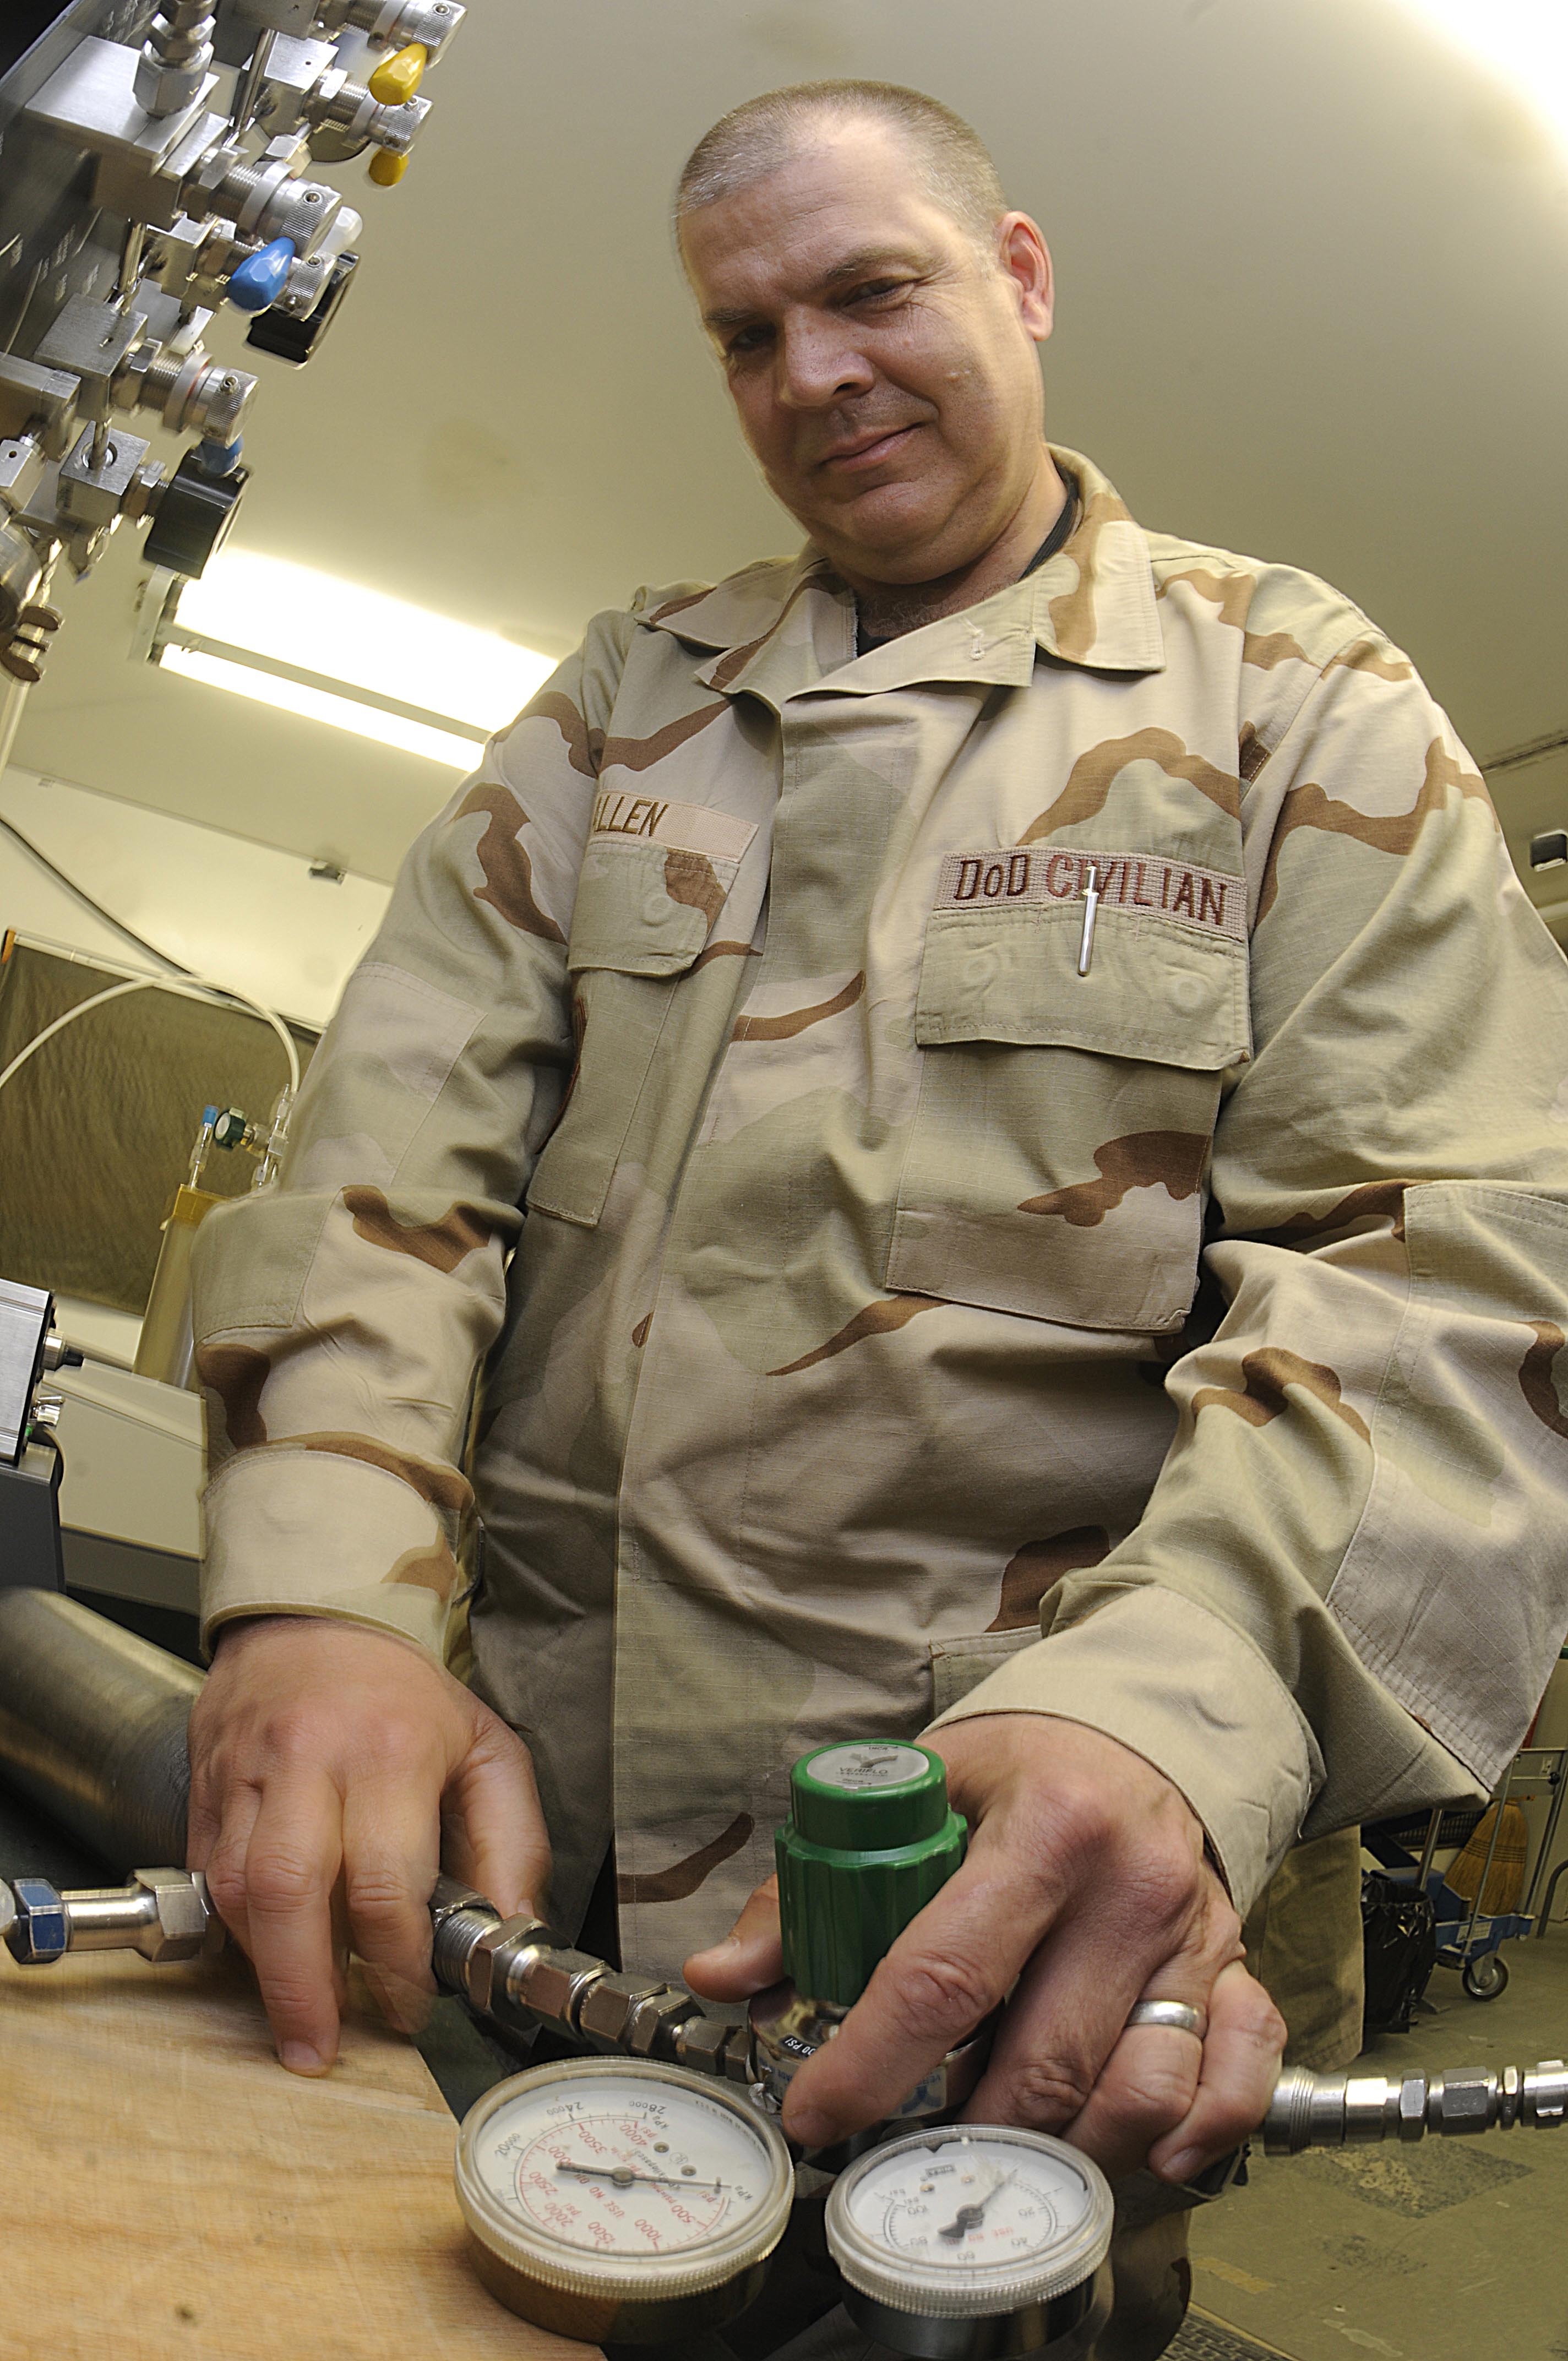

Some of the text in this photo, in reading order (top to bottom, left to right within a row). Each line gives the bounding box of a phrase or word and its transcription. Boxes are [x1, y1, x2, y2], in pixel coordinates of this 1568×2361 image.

[954, 853, 1228, 926] DoD CIVILIAN
[785, 2037, 803, 2049] PSI
[546, 2101, 584, 2115] 24000
[629, 2101, 667, 2114] 28000
[578, 2130, 607, 2154] 3500
[619, 2124, 647, 2146] 4000
[640, 2126, 658, 2139] psi
[494, 2132, 520, 2156] 20000
[548, 2146, 571, 2167] 000
[529, 2171, 559, 2196] 2500
[589, 2186, 606, 2199] NO
[734, 2184, 754, 2201] kPa
[698, 2190, 717, 2203] psi
[545, 2202, 574, 2227] 2000
[603, 2200, 625, 2218] USE
[671, 2204, 696, 2224] 500
[1018, 2206, 1036, 2217] 20
[587, 2221, 616, 2244] 1500
[634, 2218, 662, 2241] 1000
